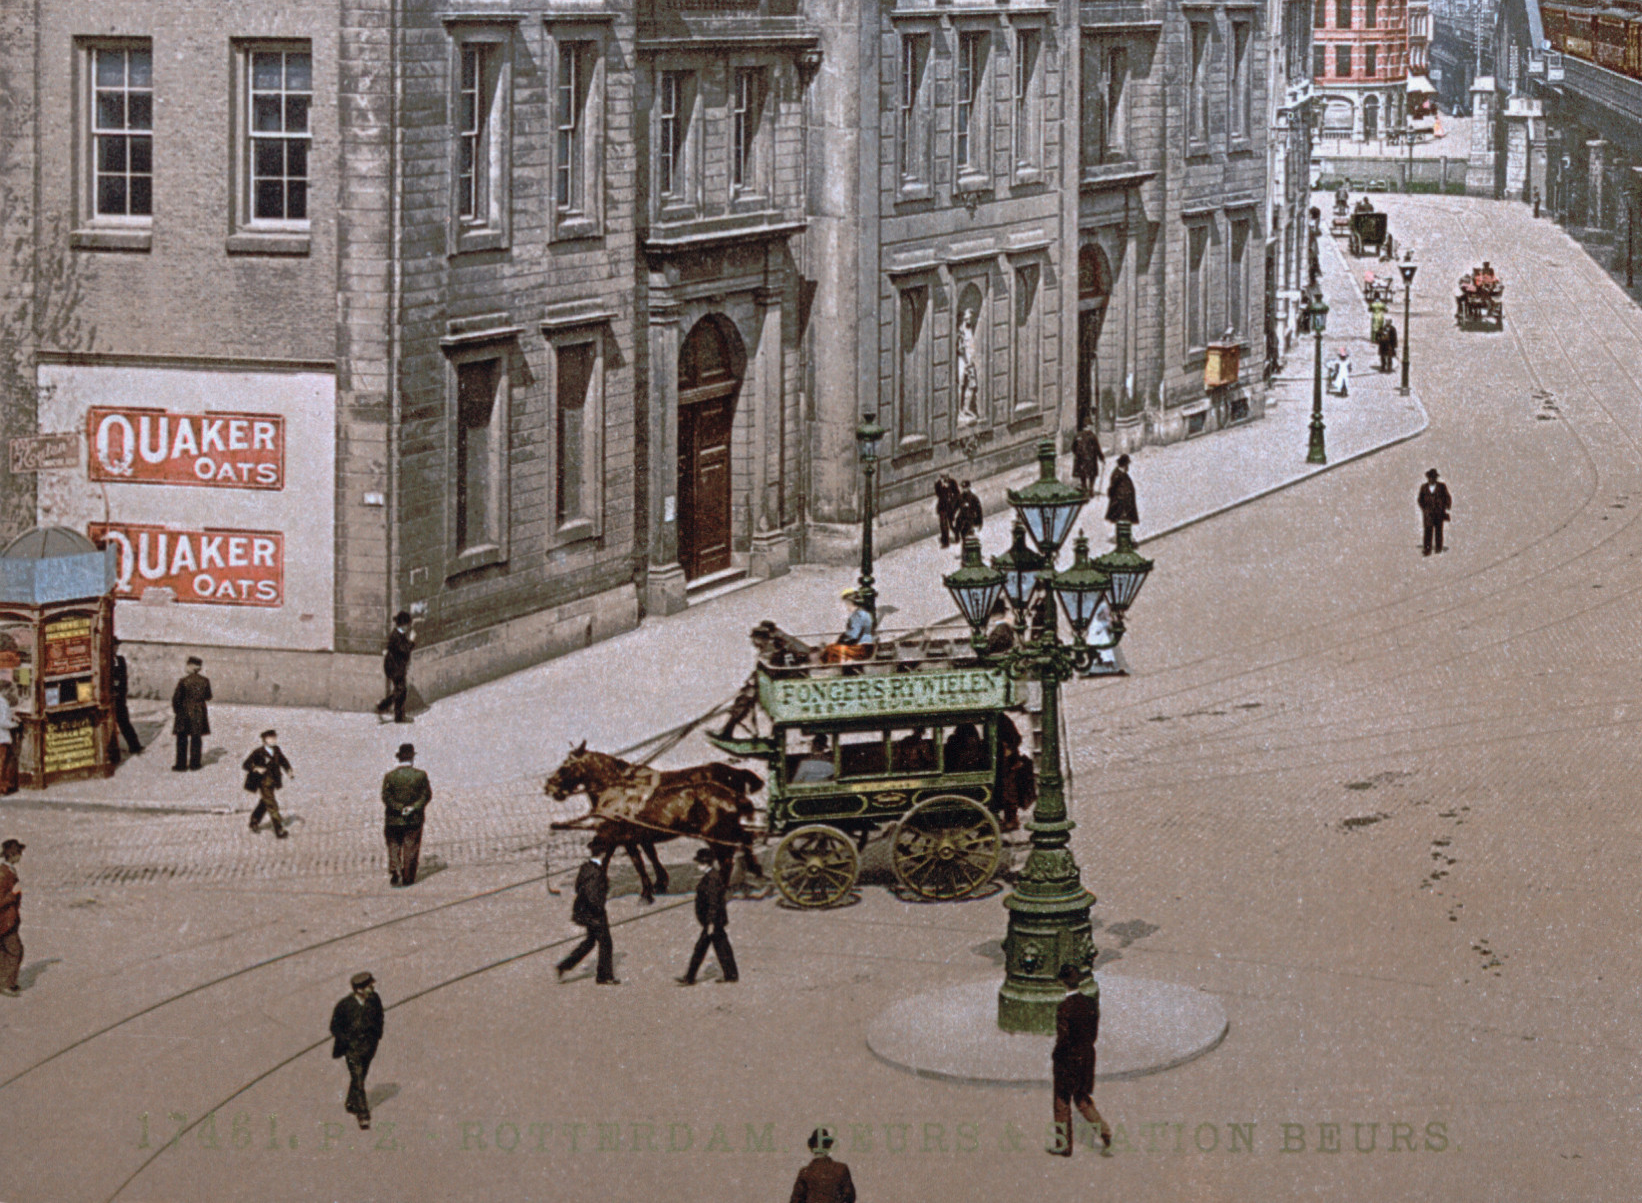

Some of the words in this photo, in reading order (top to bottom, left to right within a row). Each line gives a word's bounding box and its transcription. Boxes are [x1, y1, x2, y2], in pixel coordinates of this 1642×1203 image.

[96, 413, 277, 477] QUAKER
[193, 456, 278, 484] OATS
[192, 573, 278, 600] OATS
[781, 679, 885, 706] FONGERS
